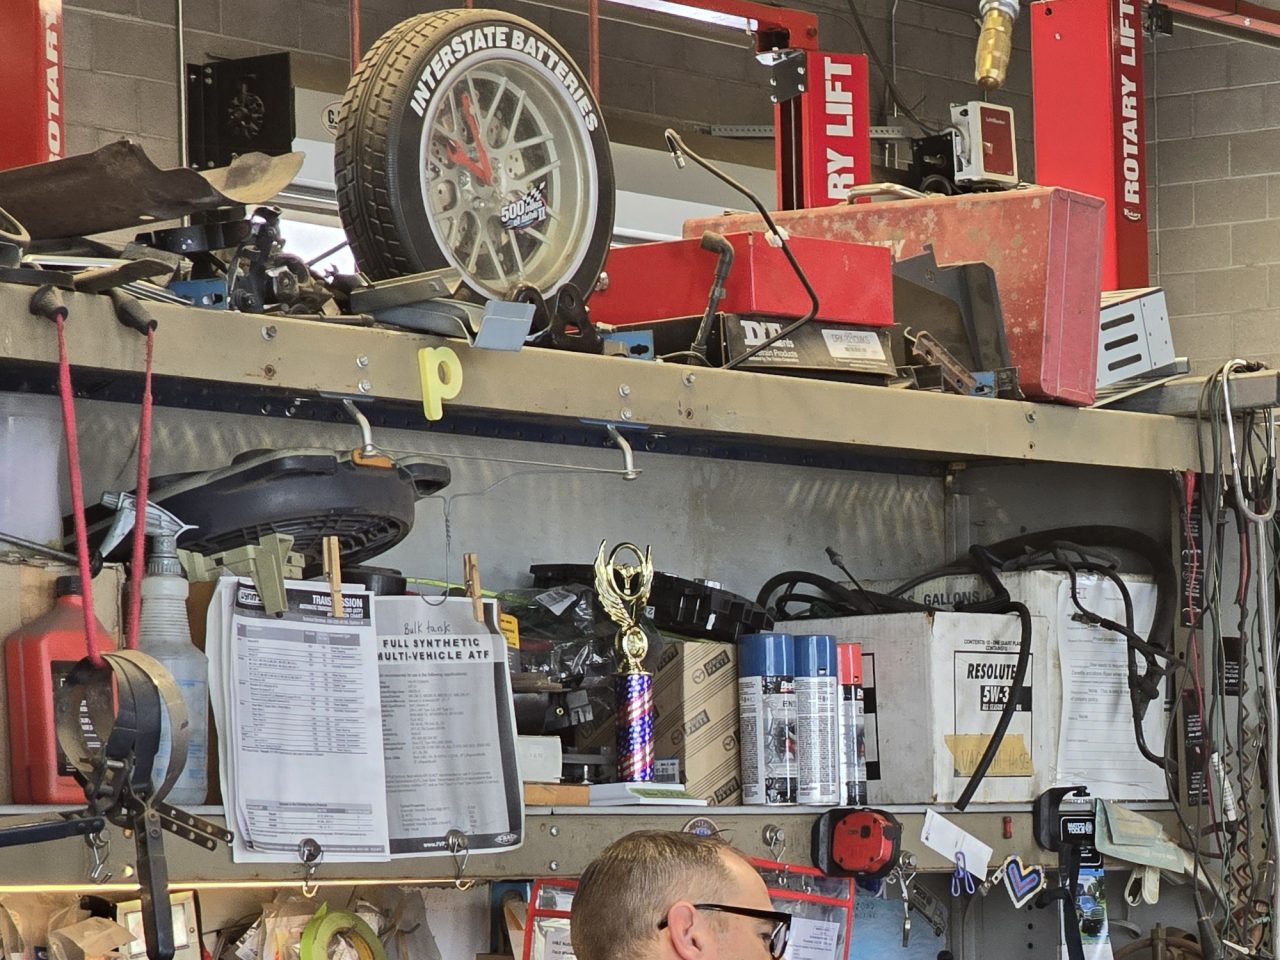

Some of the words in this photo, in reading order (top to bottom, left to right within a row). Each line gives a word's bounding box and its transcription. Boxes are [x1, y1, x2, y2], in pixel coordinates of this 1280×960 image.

[1119, 0, 1136, 67] LIFT
[410, 27, 509, 117] INTERSTATE
[511, 31, 599, 132] BATTERIES
[824, 56, 854, 137] LIFT
[1121, 74, 1140, 204] ROTARY
[501, 200, 525, 222] 500
[312, 594, 363, 608] TRANSSSION
[923, 591, 980, 607] GALLONS
[403, 621, 422, 636] Bulk
[426, 621, 451, 634] tank
[383, 639, 409, 648] FULL
[413, 638, 480, 648] SYNTHETIC
[378, 651, 462, 661] MULTI-VEHICLE
[468, 650, 489, 659] ATF
[967, 663, 1016, 680] RESOLUTE
[982, 686, 1009, 703] 5W-3
